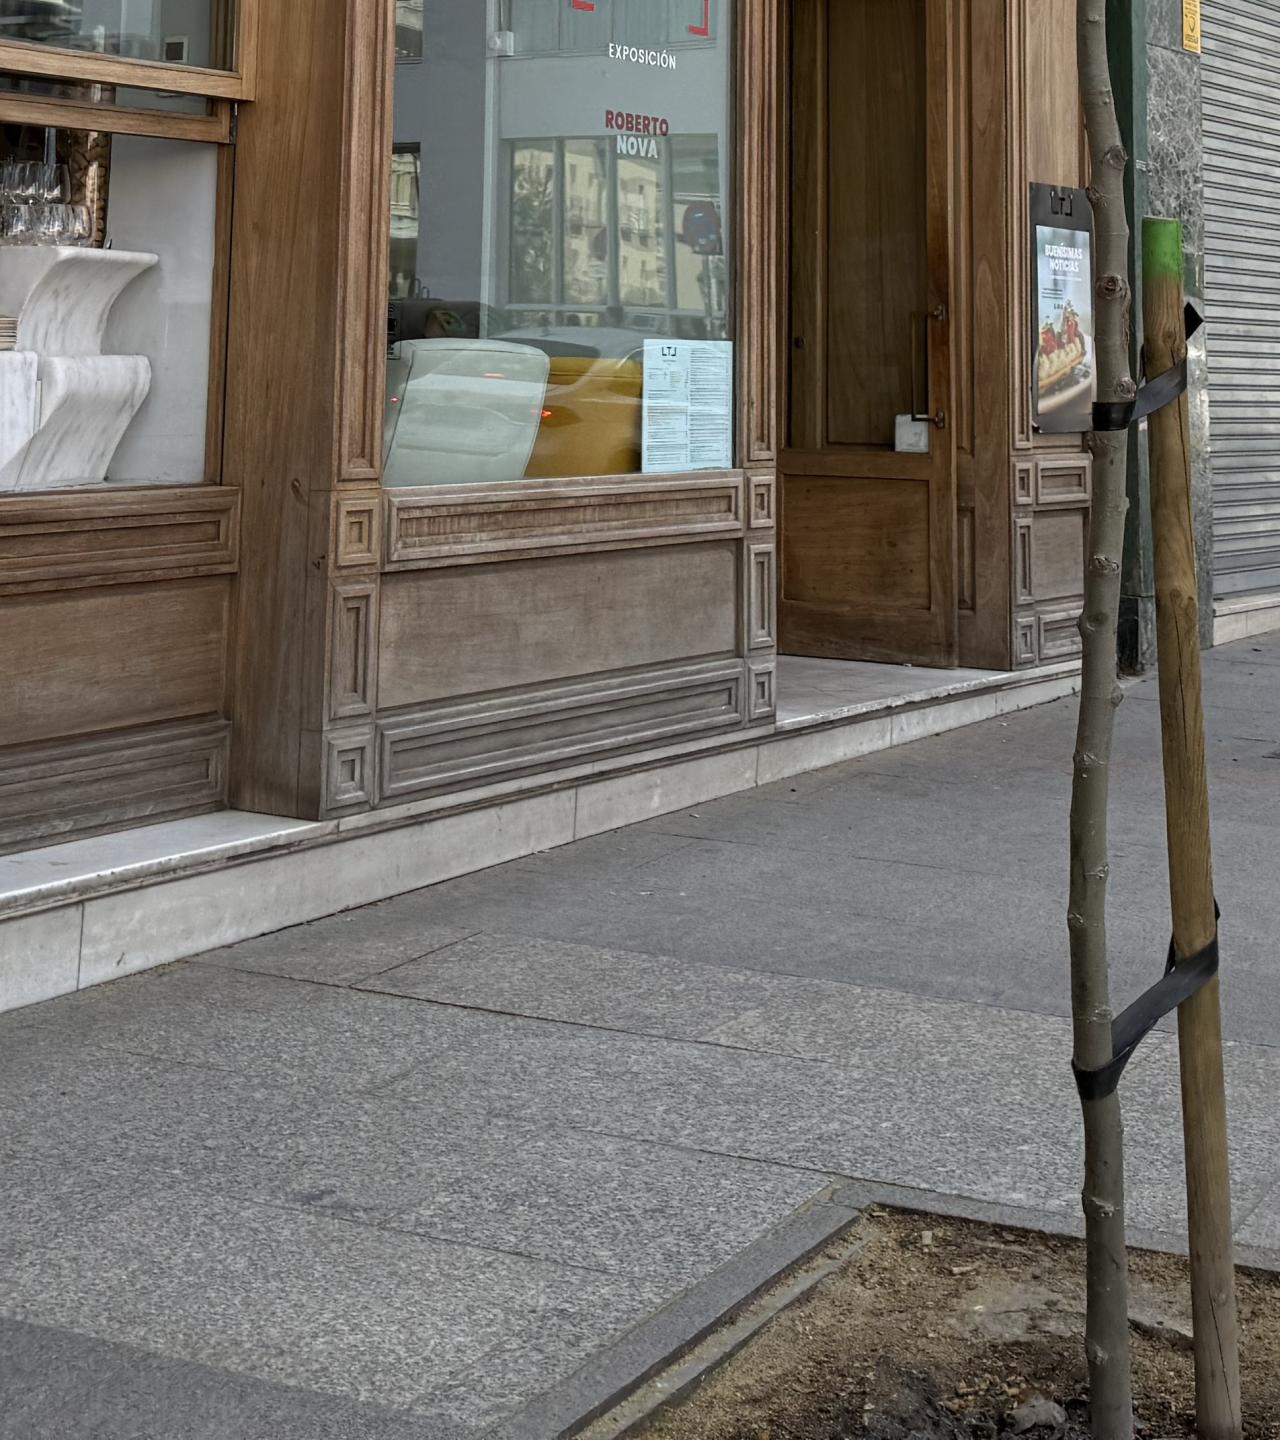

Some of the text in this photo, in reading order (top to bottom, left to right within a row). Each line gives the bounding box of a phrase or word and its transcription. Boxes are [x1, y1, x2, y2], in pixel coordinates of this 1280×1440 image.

[609, 43, 677, 69] EXPOSICIÓN
[605, 109, 669, 137] ROBERTO
[616, 136, 658, 159] NOVA
